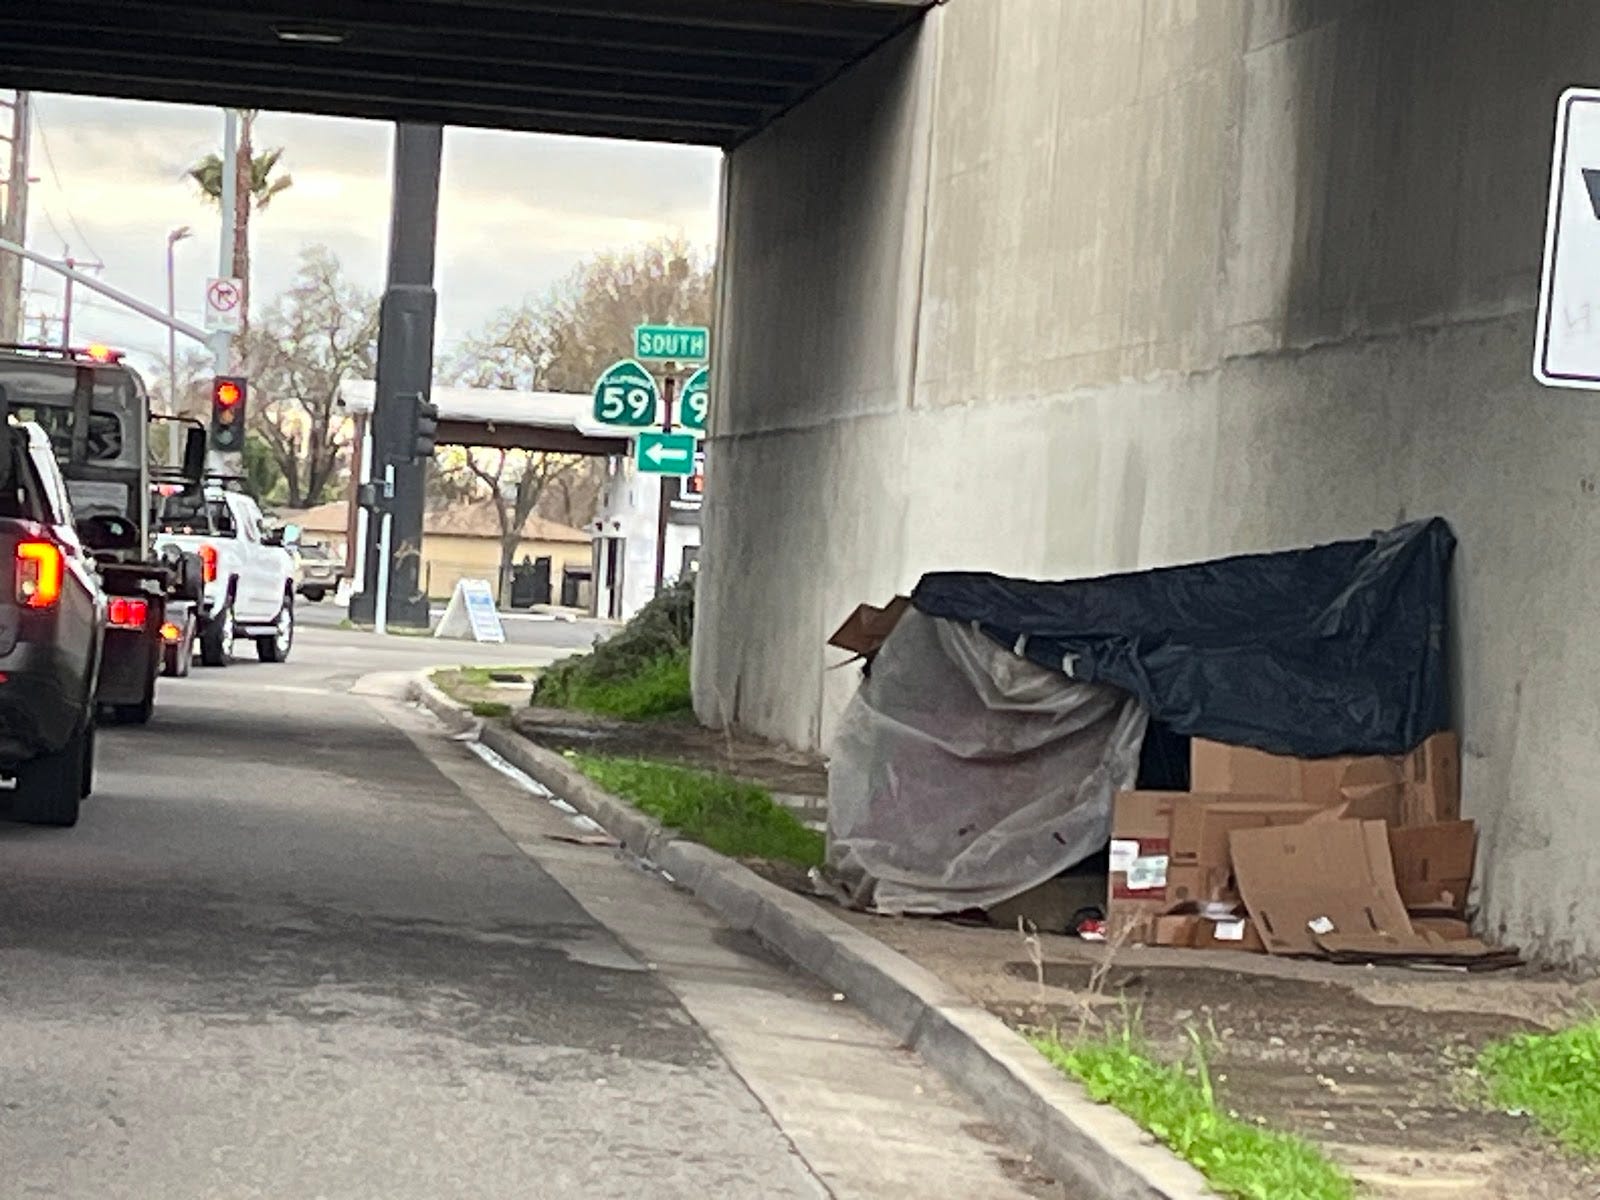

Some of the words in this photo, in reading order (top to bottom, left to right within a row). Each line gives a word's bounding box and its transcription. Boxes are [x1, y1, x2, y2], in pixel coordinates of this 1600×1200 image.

[640, 332, 704, 355] SOUTH
[601, 387, 650, 419] 59
[689, 392, 708, 423] 9
